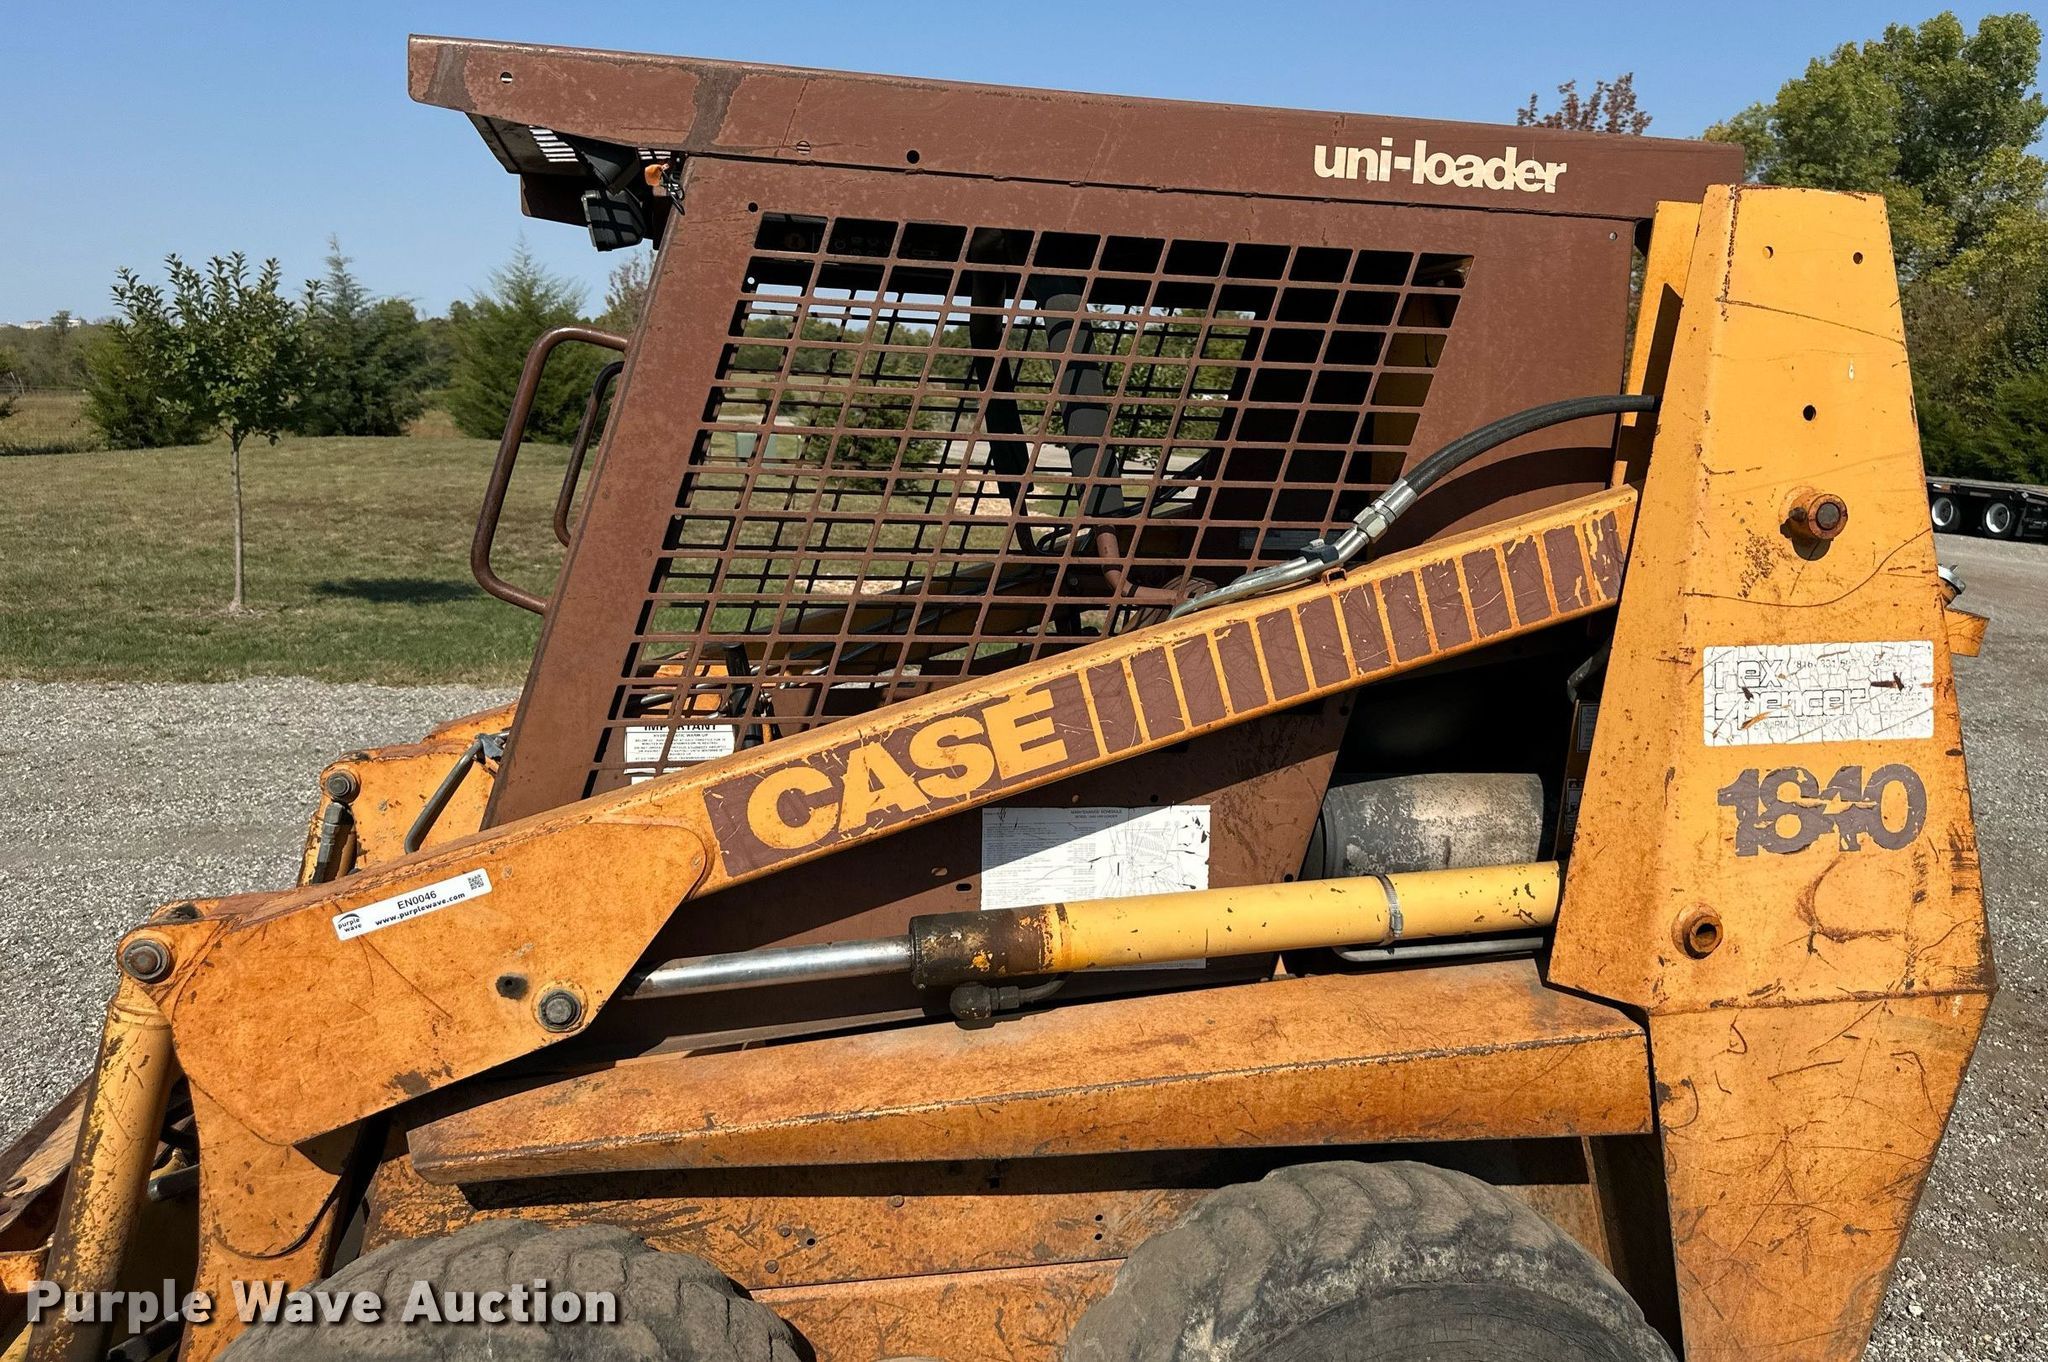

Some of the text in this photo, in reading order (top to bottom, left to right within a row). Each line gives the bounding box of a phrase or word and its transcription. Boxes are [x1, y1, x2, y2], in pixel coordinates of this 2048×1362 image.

[1314, 136, 1567, 193] uni-loader
[747, 686, 1069, 850] CASE
[1717, 763, 1927, 857] 1840
[375, 892, 466, 926] www.purplewave.com
[397, 890, 437, 910] EN0046
[338, 917, 361, 930] purple
[344, 923, 363, 932] wave
